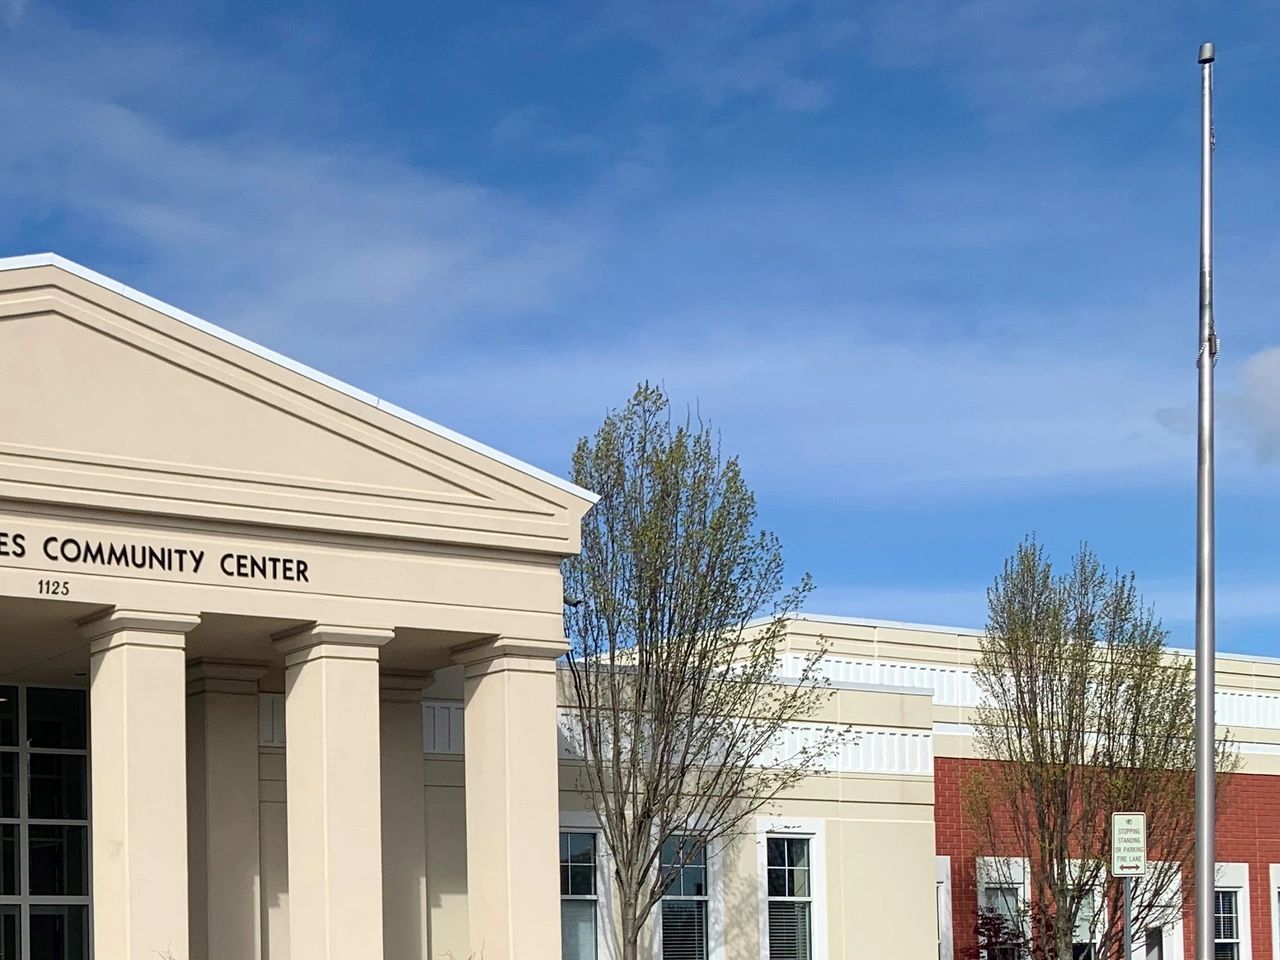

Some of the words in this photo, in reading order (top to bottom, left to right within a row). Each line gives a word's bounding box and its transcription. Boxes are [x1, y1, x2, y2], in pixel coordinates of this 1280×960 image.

[43, 536, 205, 574] COMMUNITY
[220, 553, 309, 583] CENTER
[38, 579, 69, 596] 1125
